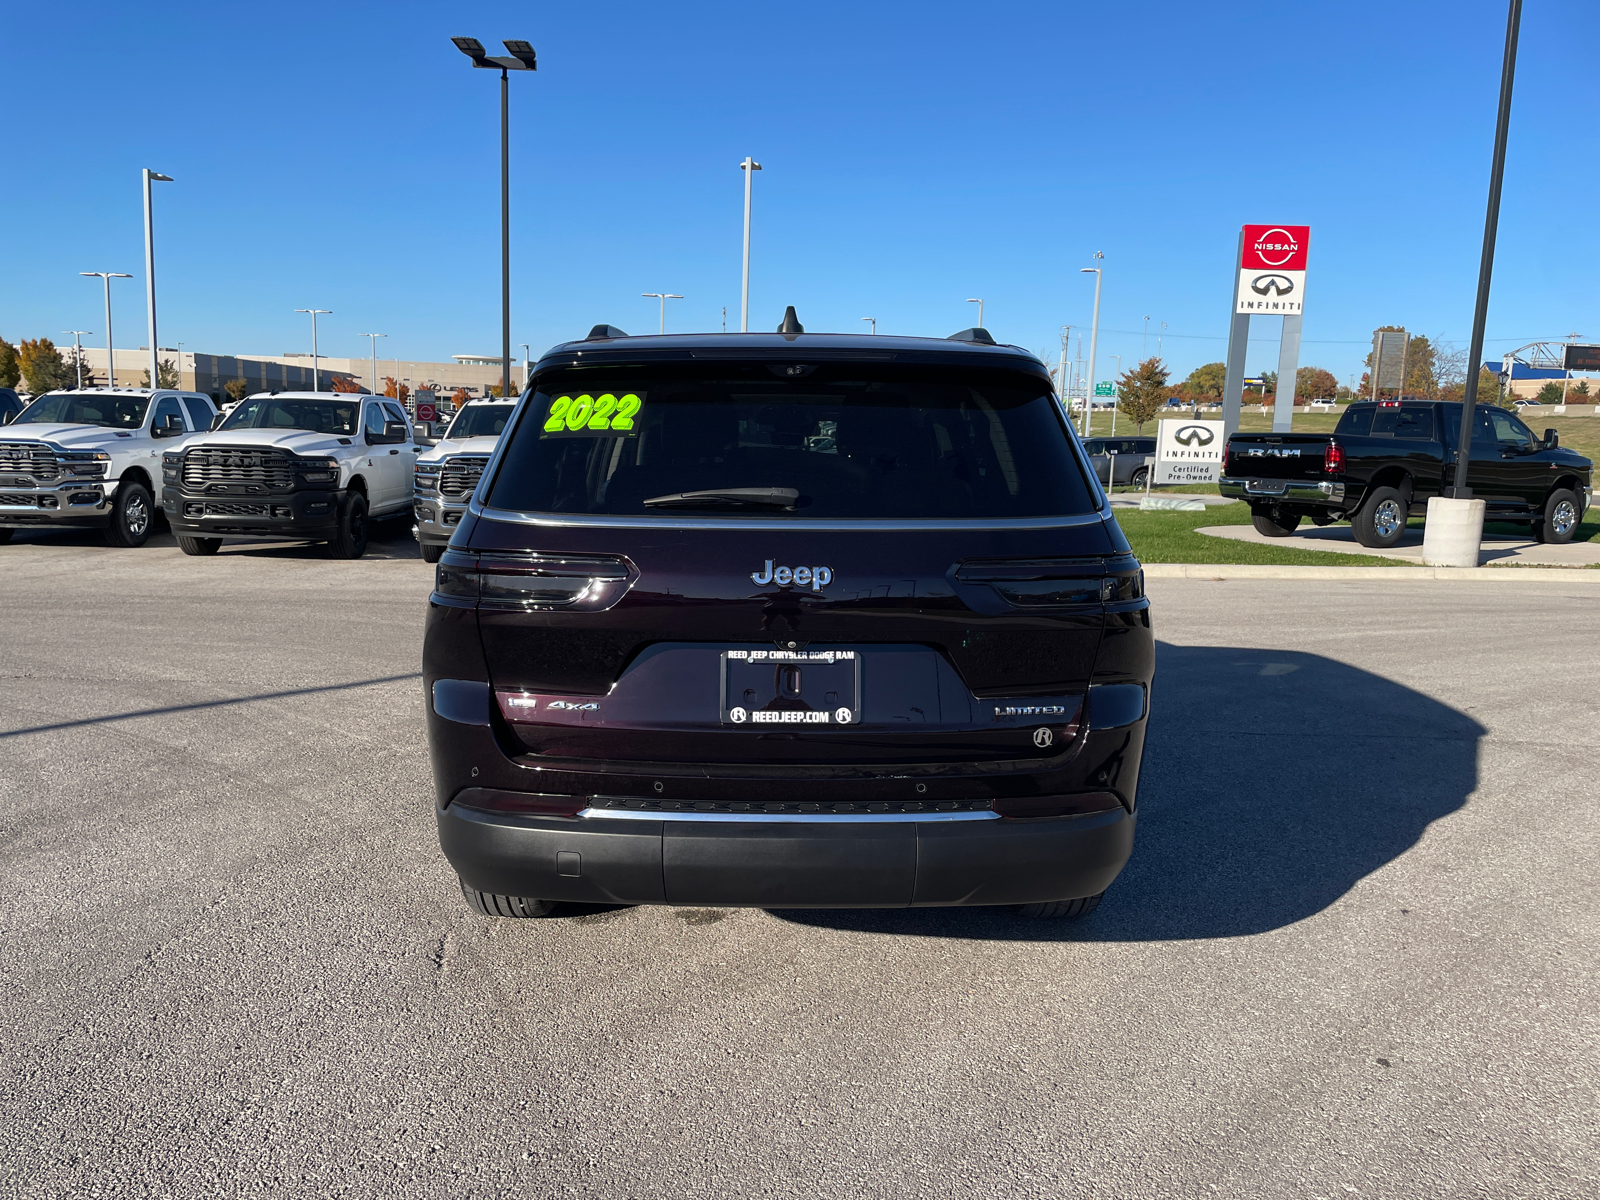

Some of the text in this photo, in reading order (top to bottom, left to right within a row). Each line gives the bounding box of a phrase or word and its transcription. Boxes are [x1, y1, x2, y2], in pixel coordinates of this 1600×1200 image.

[1254, 243, 1298, 251] NISSAN
[1240, 301, 1301, 310] INFINITI
[543, 393, 642, 433] 2022
[1166, 450, 1219, 459] INFINITI
[1248, 448, 1301, 458] RAM
[206, 455, 262, 467] RAM
[1172, 465, 1210, 473] Certified
[1167, 473, 1213, 481] Pre-Owned
[750, 558, 835, 592] Jeep
[727, 650, 855, 660] REED JEEP CHRYSLER DODGE RAM
[547, 700, 599, 711] 4x4
[994, 705, 1065, 716] LIMITED
[752, 711, 829, 723] REEDJEEP.COM
